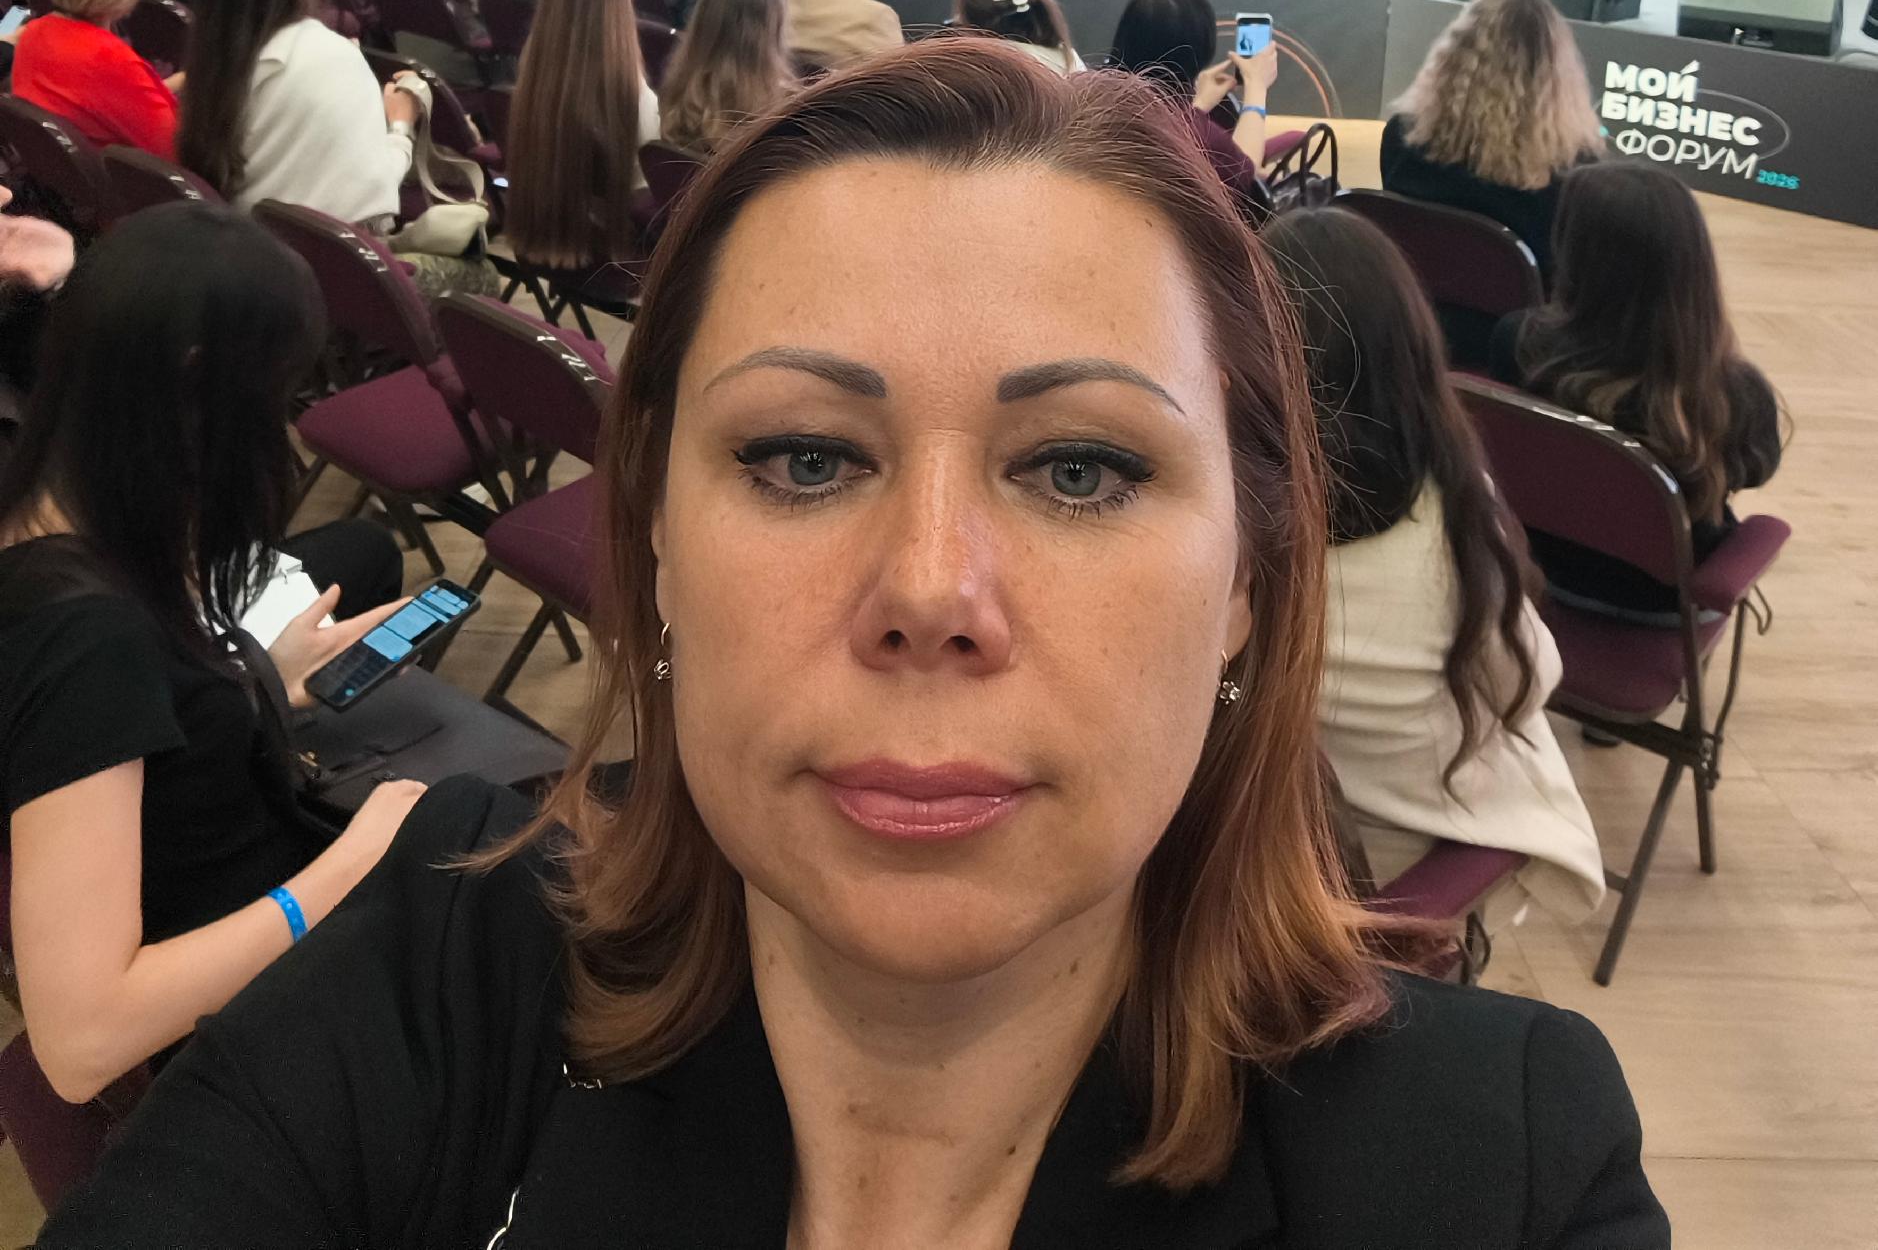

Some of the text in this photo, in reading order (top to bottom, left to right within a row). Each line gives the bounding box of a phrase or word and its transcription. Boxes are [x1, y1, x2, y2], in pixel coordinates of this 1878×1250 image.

[1605, 60, 1700, 103] МОЙ
[1601, 90, 1763, 146] БИЗНЕС
[1616, 128, 1760, 180] ФОРУМ
